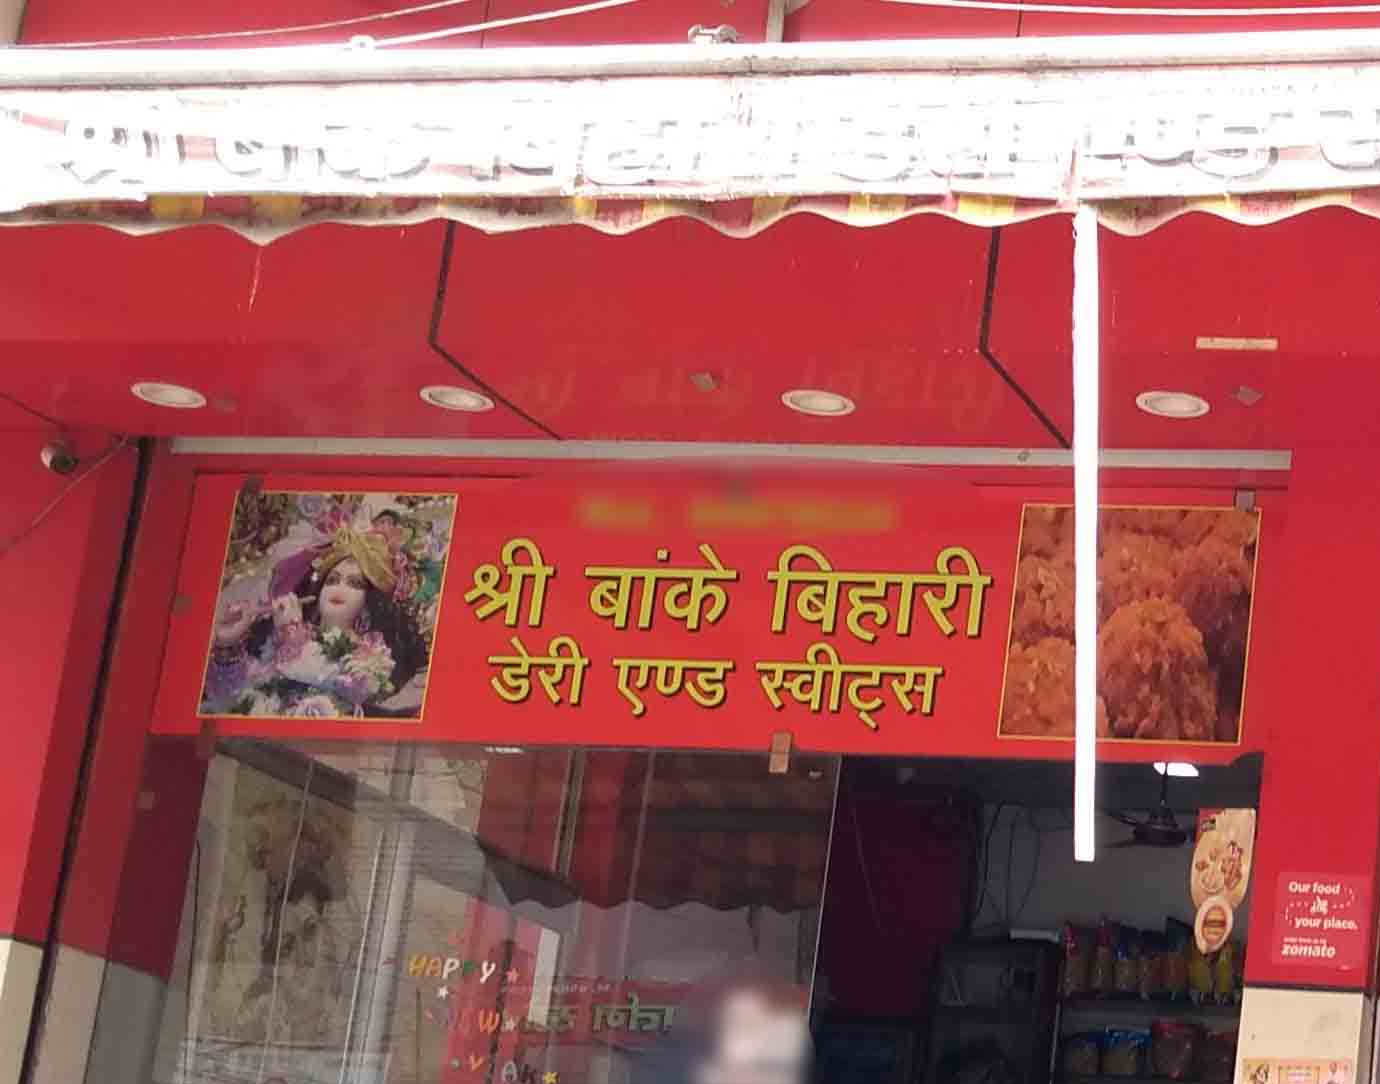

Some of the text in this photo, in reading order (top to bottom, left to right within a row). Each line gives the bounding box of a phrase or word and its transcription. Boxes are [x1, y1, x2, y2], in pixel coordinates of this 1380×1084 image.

[464, 538, 992, 645] श्री बांके बिहारी
[488, 635, 943, 728] डेरी एण्ड स्वीट्स
[1288, 880, 1341, 896] Our food
[1294, 915, 1358, 932] your place.
[1281, 943, 1336, 958] zomato
